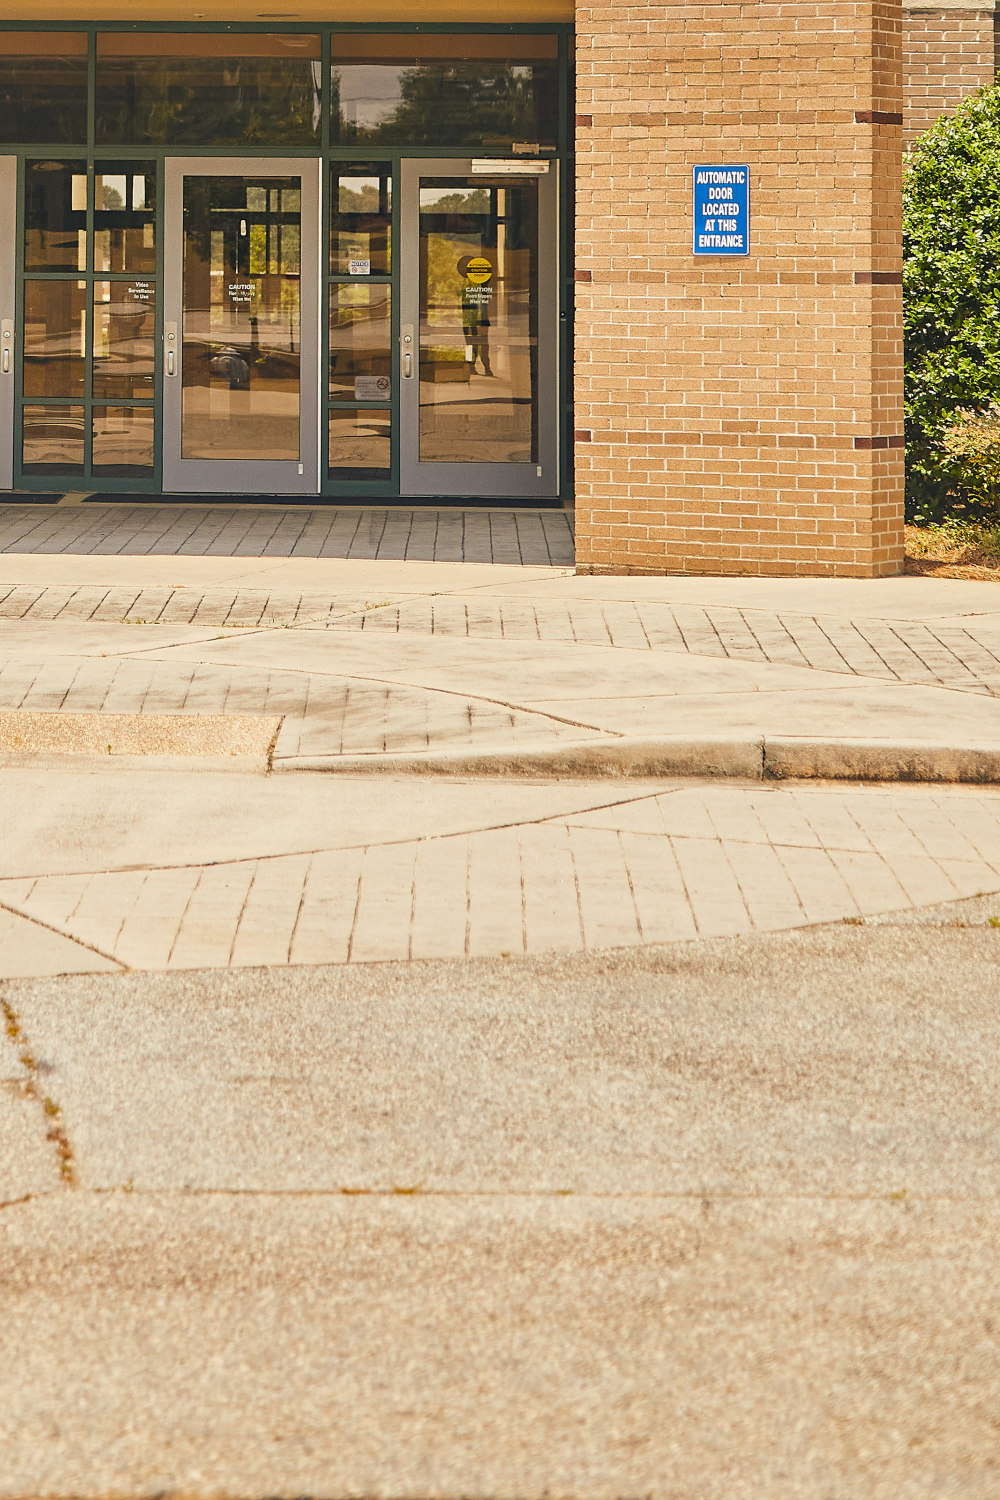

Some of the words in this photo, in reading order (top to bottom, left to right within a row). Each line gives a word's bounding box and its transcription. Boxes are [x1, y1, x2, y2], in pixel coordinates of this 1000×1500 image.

[696, 171, 745, 184] AUTOMATIC
[708, 187, 733, 200] DOOR
[702, 203, 740, 216] LOCATED
[704, 219, 716, 232] AT
[717, 219, 737, 232] THIS
[698, 234, 743, 248] ENTRANCE
